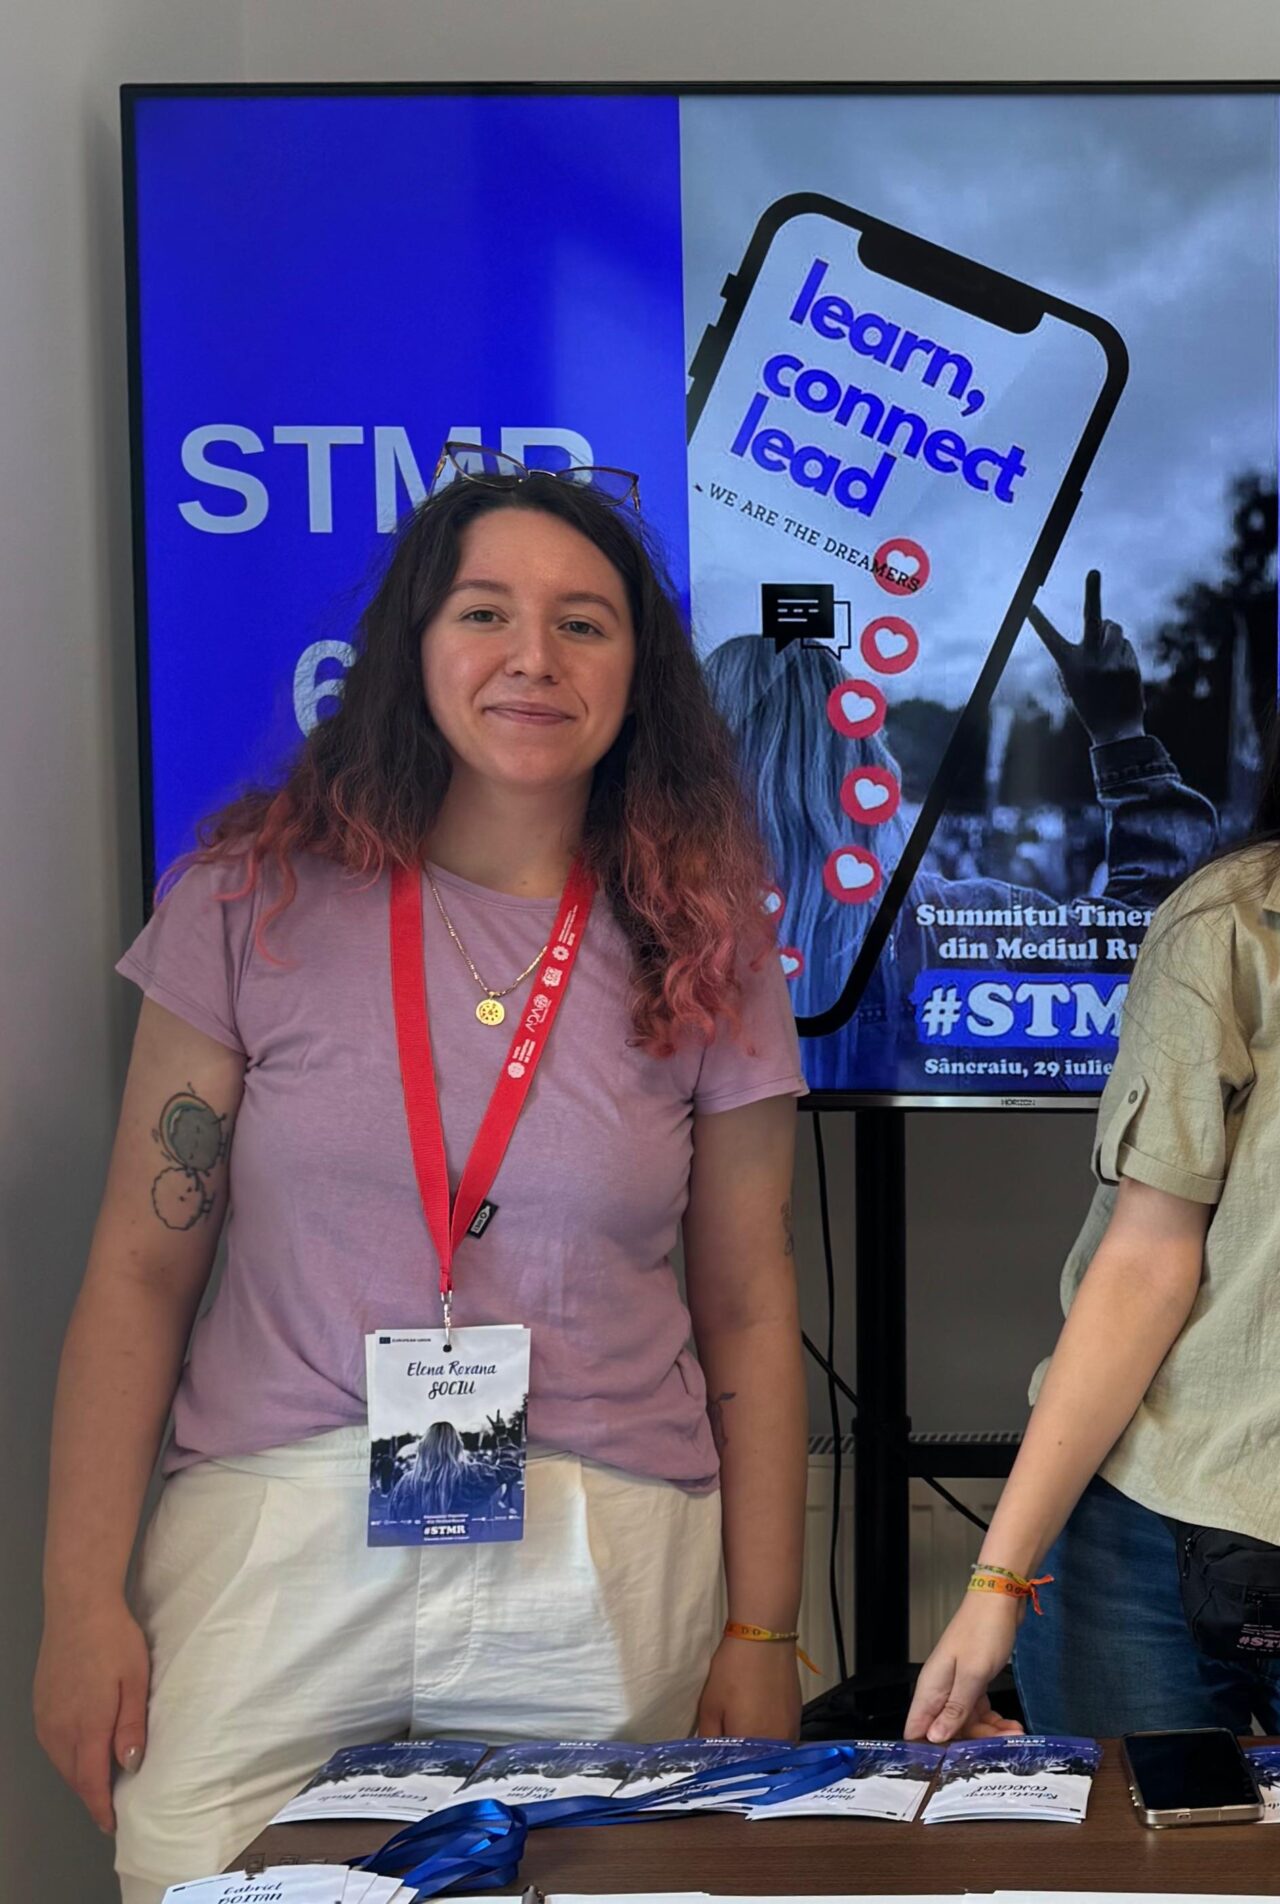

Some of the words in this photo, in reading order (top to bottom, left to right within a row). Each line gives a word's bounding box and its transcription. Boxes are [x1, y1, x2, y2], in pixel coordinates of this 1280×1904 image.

[789, 258, 985, 417] learn,
[762, 354, 1027, 503] connect
[730, 392, 897, 517] lead
[709, 483, 738, 507] WE
[741, 497, 777, 527] ARE
[784, 518, 821, 546] THE
[822, 537, 920, 593] DREAMERS
[916, 903, 1069, 927] Summitul
[939, 937, 989, 960] din
[996, 937, 1098, 960] Mediul
[924, 1058, 1029, 1079] Sâncraiu,
[1033, 1061, 1061, 1078] 29
[407, 1360, 445, 1376] Elena
[449, 1360, 497, 1376] Roxana
[428, 1380, 477, 1400] SOCIU
